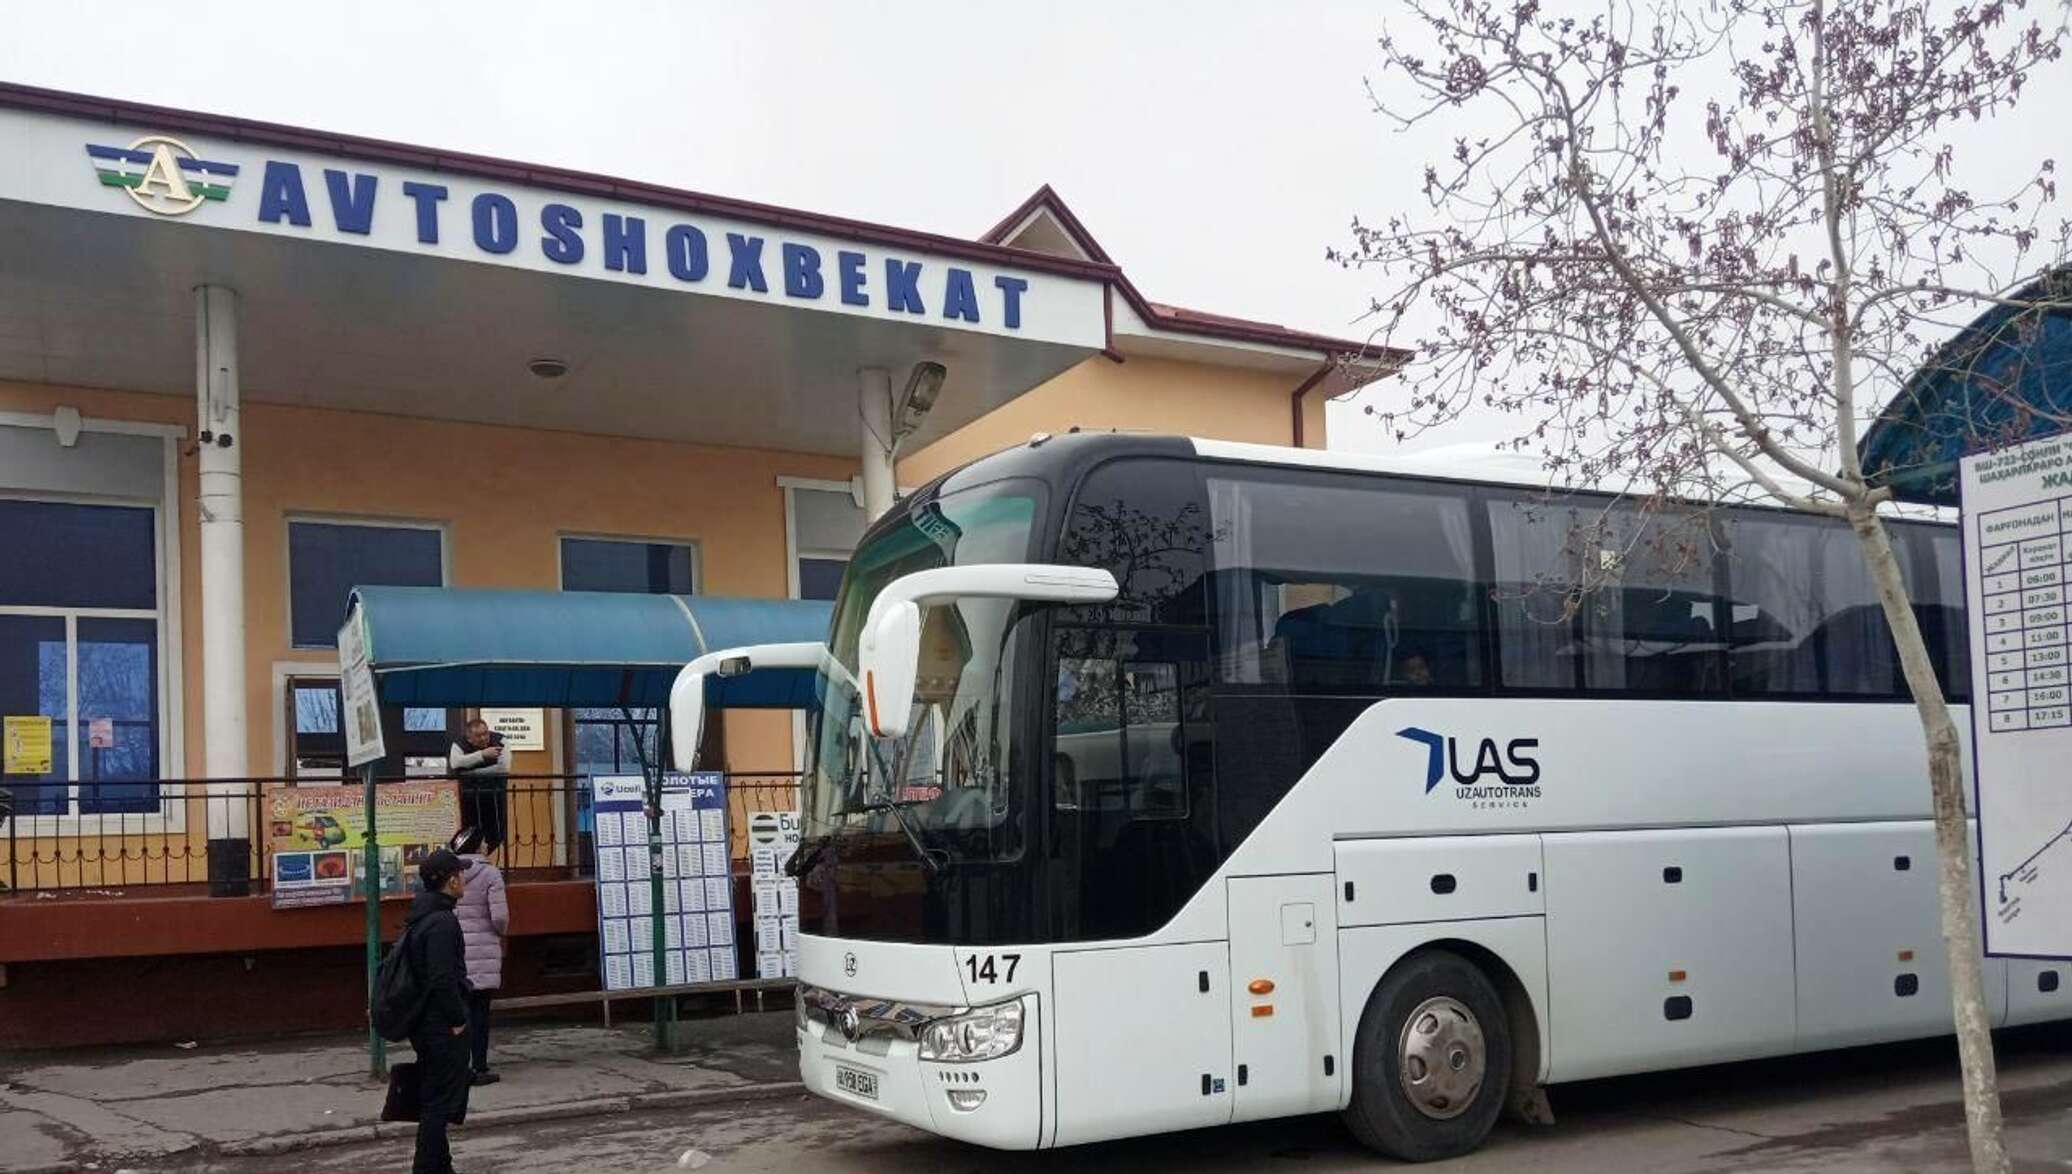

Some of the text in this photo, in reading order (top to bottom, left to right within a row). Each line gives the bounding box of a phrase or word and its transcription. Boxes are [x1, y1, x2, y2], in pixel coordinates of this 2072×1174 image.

[133, 144, 194, 202] A
[258, 160, 1028, 329] AVTOSHOXBEKAT
[660, 775, 718, 786] ОЛОТЫЕ
[1448, 737, 1540, 785] UAS
[1456, 786, 1541, 799] UZAUTOTRANS
[966, 954, 1021, 984] 147
